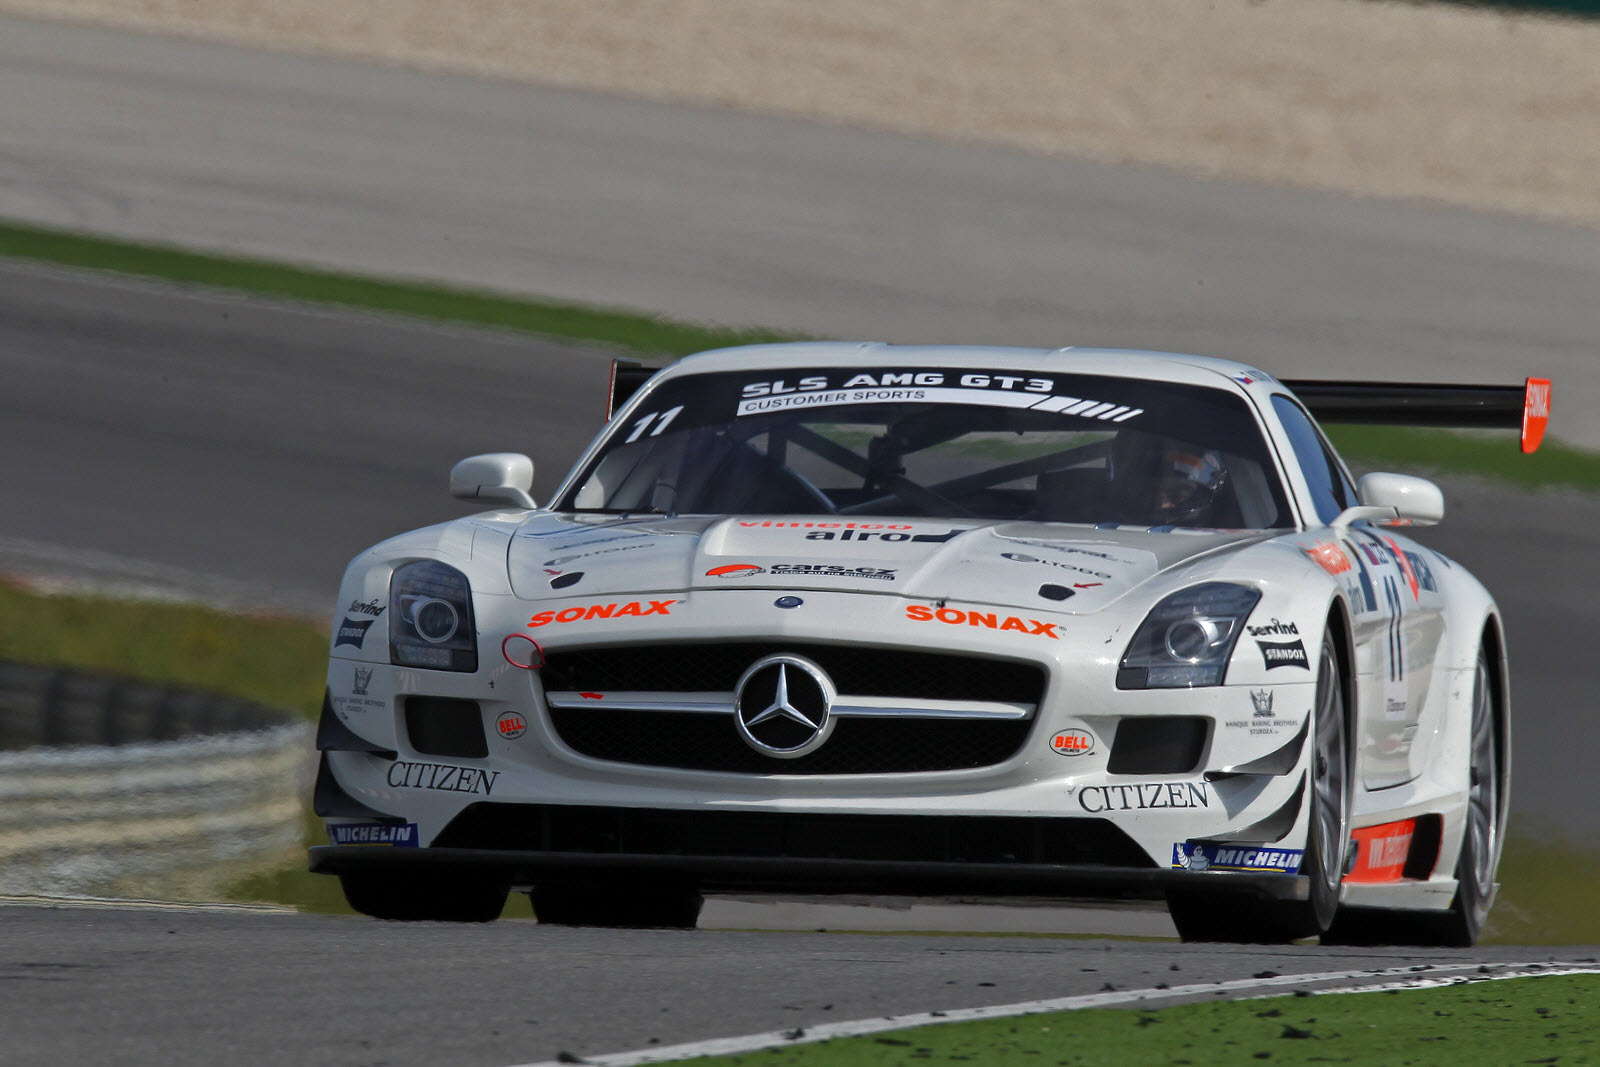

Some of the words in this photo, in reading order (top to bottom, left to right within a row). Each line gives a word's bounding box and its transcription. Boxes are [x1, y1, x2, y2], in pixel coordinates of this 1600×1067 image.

[742, 376, 828, 397] SLS
[843, 373, 945, 387] AMG
[960, 374, 1054, 392] GT3
[745, 392, 846, 412] CUSTOMER
[853, 389, 925, 400] SPORTS
[625, 405, 685, 444] 11
[738, 520, 914, 531] vimetco
[805, 529, 911, 543] alro
[770, 563, 898, 576] cars.cz
[527, 600, 678, 628] SONAX
[906, 605, 1060, 640] SONAX
[1265, 648, 1305, 661] STANDOX
[499, 717, 526, 734] BELL
[1273, 720, 1298, 728] BROTHERS
[1054, 735, 1089, 750] BELL
[387, 761, 500, 796] CITIZEN
[1078, 782, 1210, 813] CITIZEN
[336, 826, 412, 842] MICHELIN
[1213, 849, 1304, 869] MICHELIN
